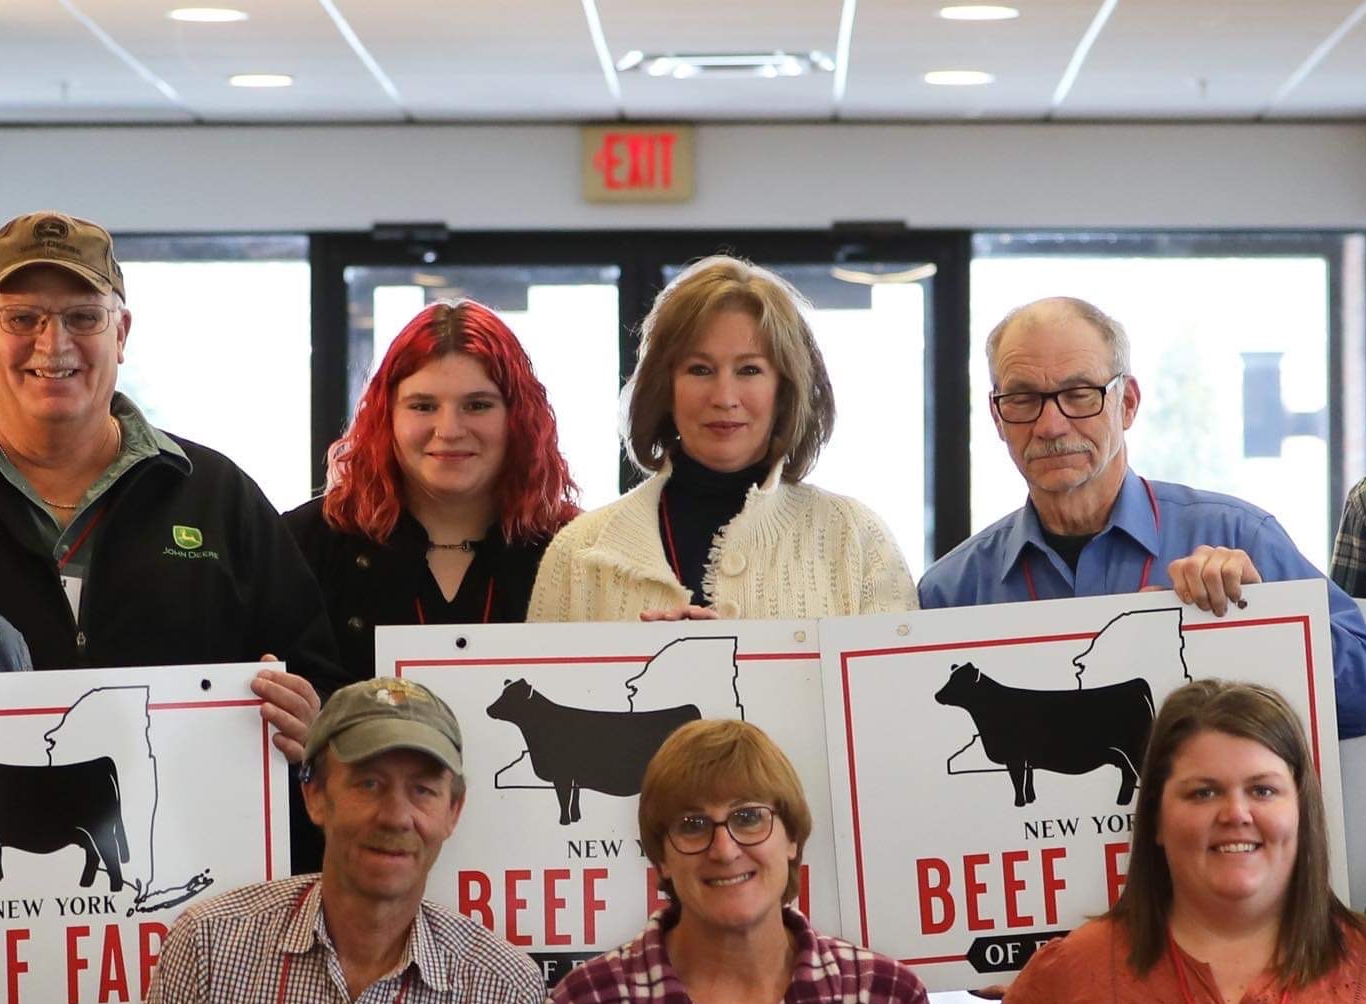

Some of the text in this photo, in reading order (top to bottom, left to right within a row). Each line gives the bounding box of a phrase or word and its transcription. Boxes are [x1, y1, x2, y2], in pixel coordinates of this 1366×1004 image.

[603, 133, 678, 190] EXIT
[162, 546, 220, 560] JOHN DEERE
[1024, 817, 1080, 840] NEW
[567, 839, 624, 858] NEW
[915, 847, 1067, 936] BEEF
[55, 894, 118, 917] YORK
[458, 868, 609, 946] BEEF
[985, 942, 1021, 966] OF
